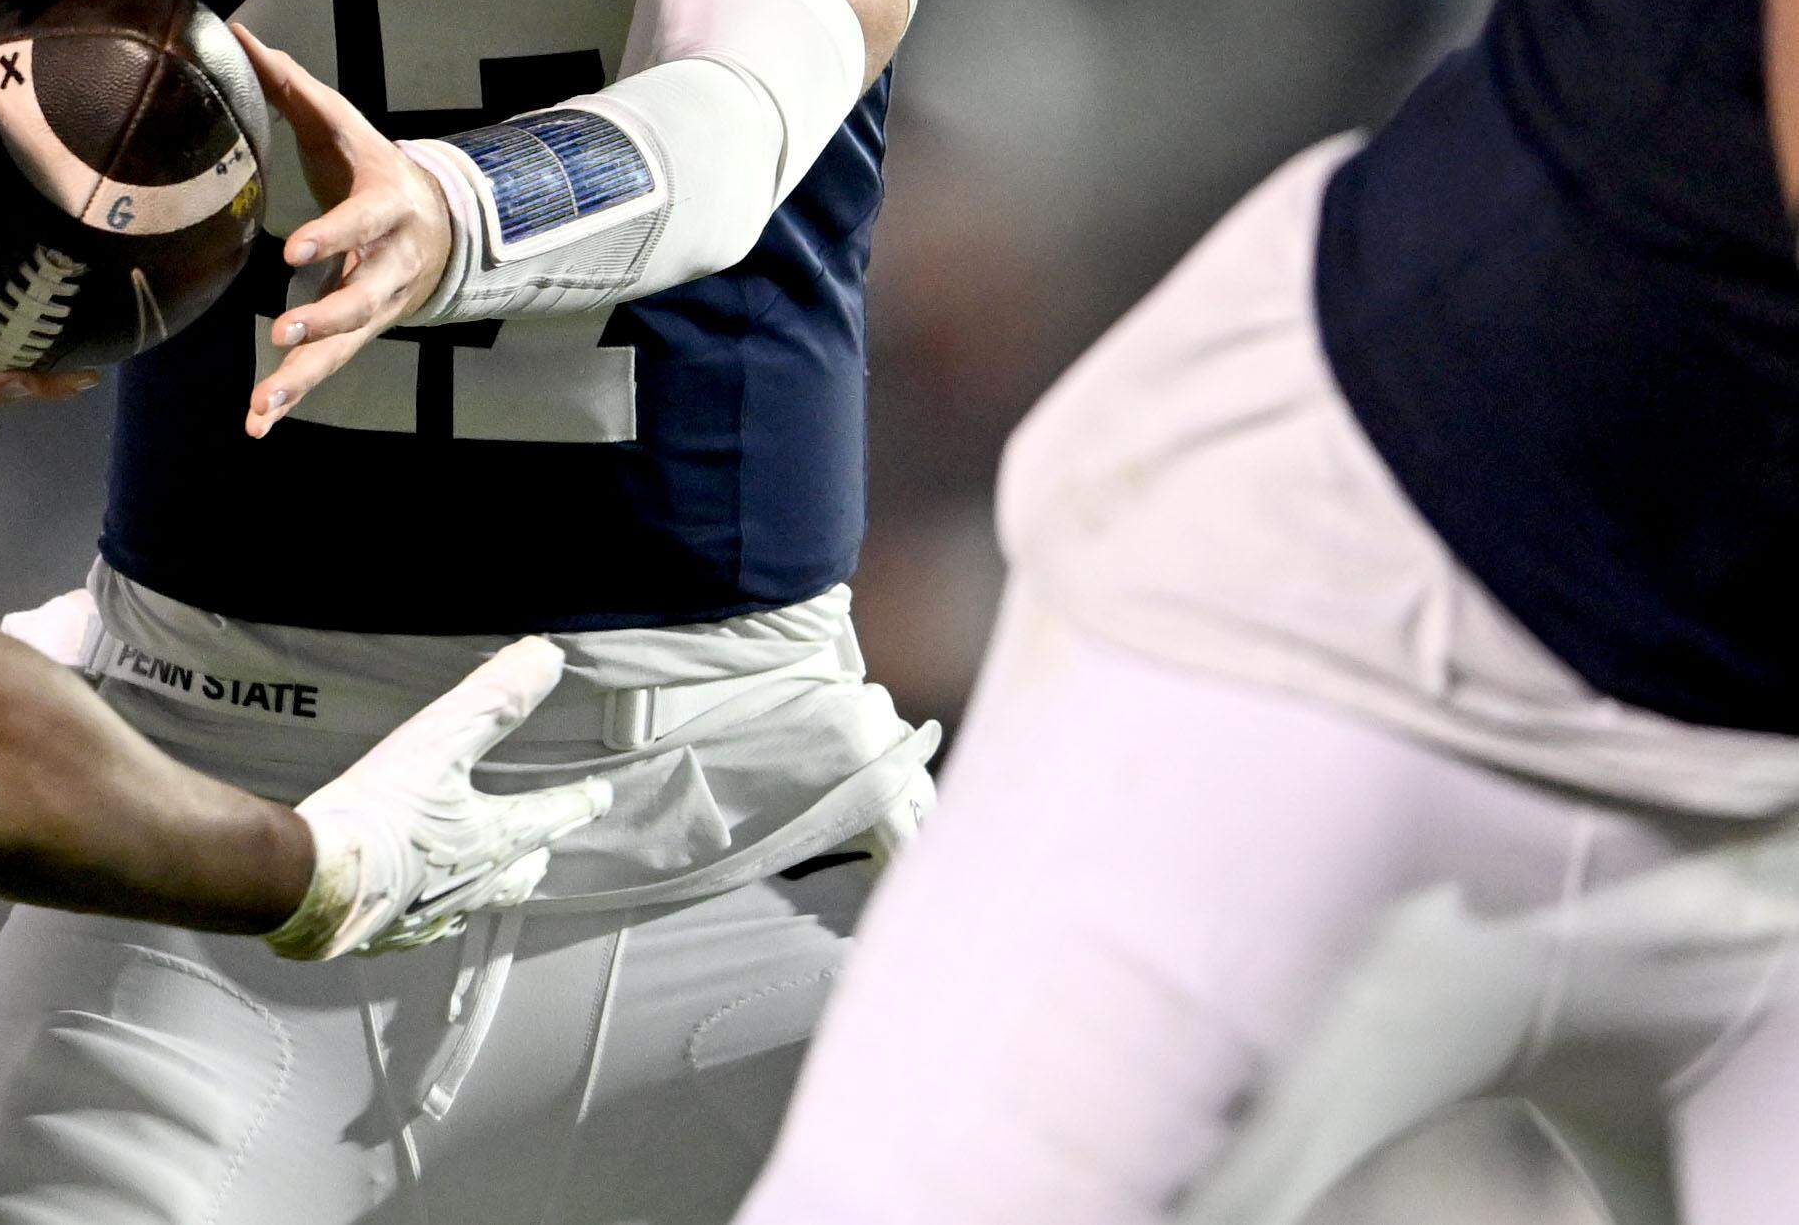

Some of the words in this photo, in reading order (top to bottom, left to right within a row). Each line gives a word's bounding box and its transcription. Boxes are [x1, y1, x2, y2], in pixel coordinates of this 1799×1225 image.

[106, 195, 135, 229] G
[117, 644, 193, 692] PENN
[202, 674, 319, 719] STATE
